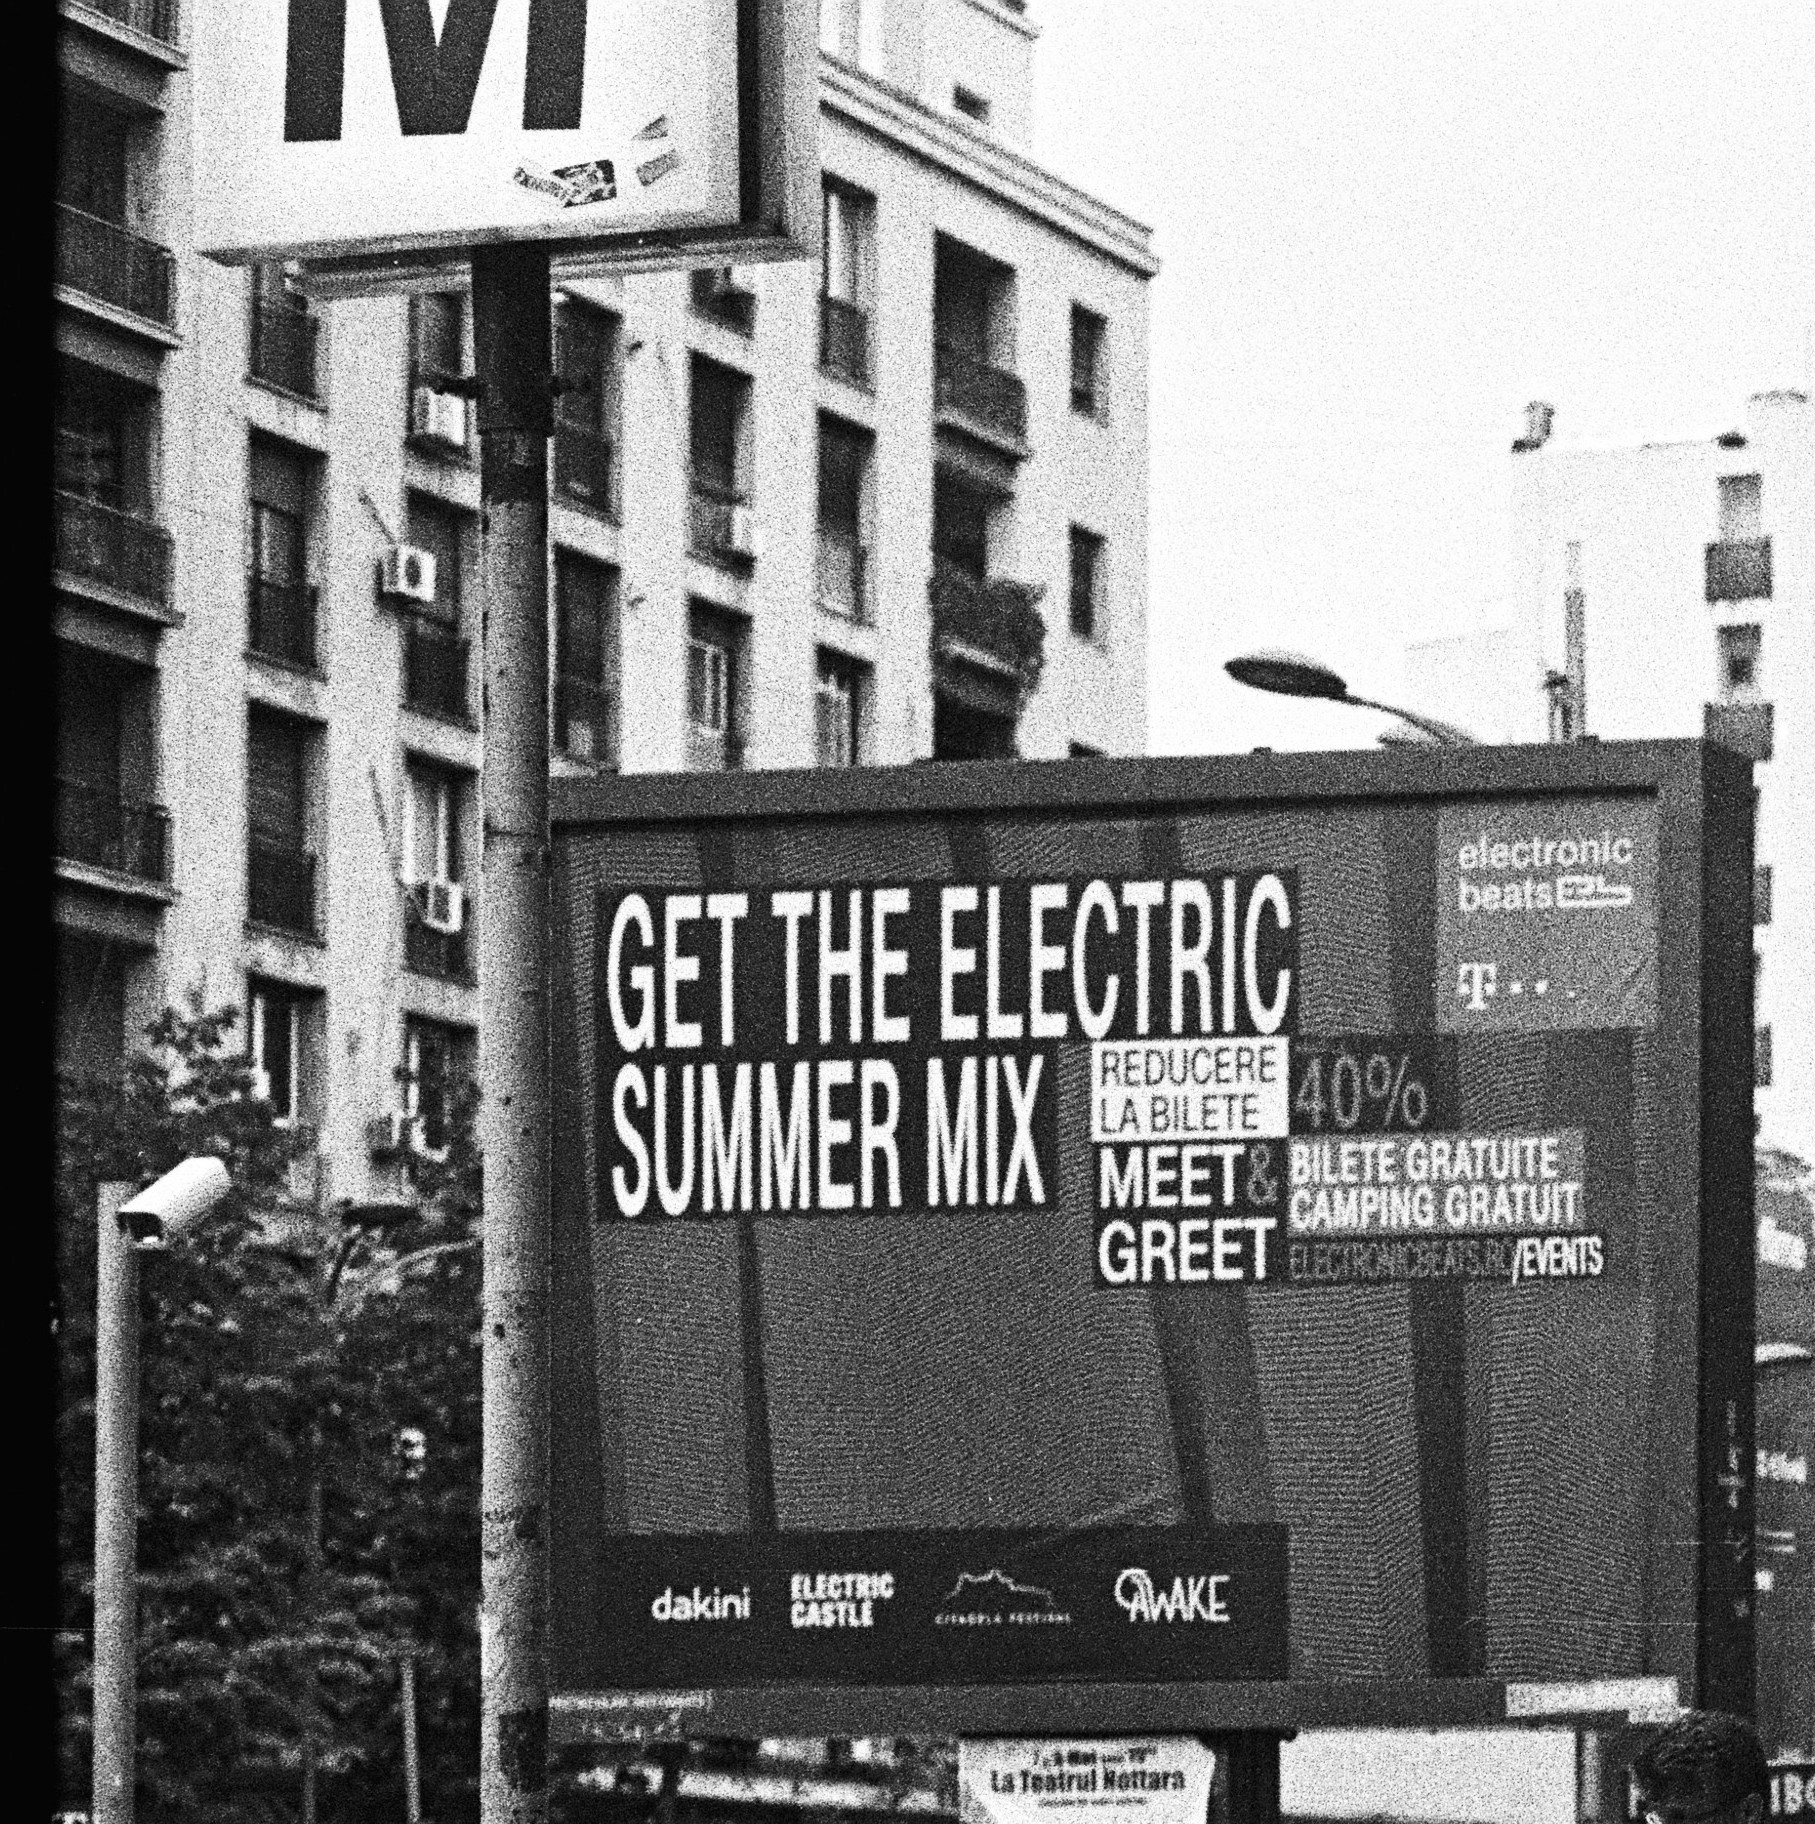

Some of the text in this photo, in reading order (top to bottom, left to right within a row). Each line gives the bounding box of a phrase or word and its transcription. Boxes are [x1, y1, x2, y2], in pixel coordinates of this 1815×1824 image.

[284, 0, 588, 142] M
[1458, 831, 1633, 869] electronic
[1459, 876, 1553, 912] beats
[607, 873, 1292, 1053] GET THE ELECTRIC
[1100, 1044, 1277, 1089] REDUCERE
[1100, 1092, 1259, 1135] LA BILETE
[1296, 1053, 1428, 1128] 40%
[612, 1053, 1046, 1218] SUMMER MIX
[1290, 1136, 1560, 1187] BILETE GRATUITE
[1290, 1181, 1582, 1231] CAMPING GRATUIT
[1099, 1216, 1278, 1285] GREET
[650, 1586, 751, 1624] dakini
[790, 1572, 895, 1601] ELECTRIC
[790, 1600, 875, 1629] CASTLE
